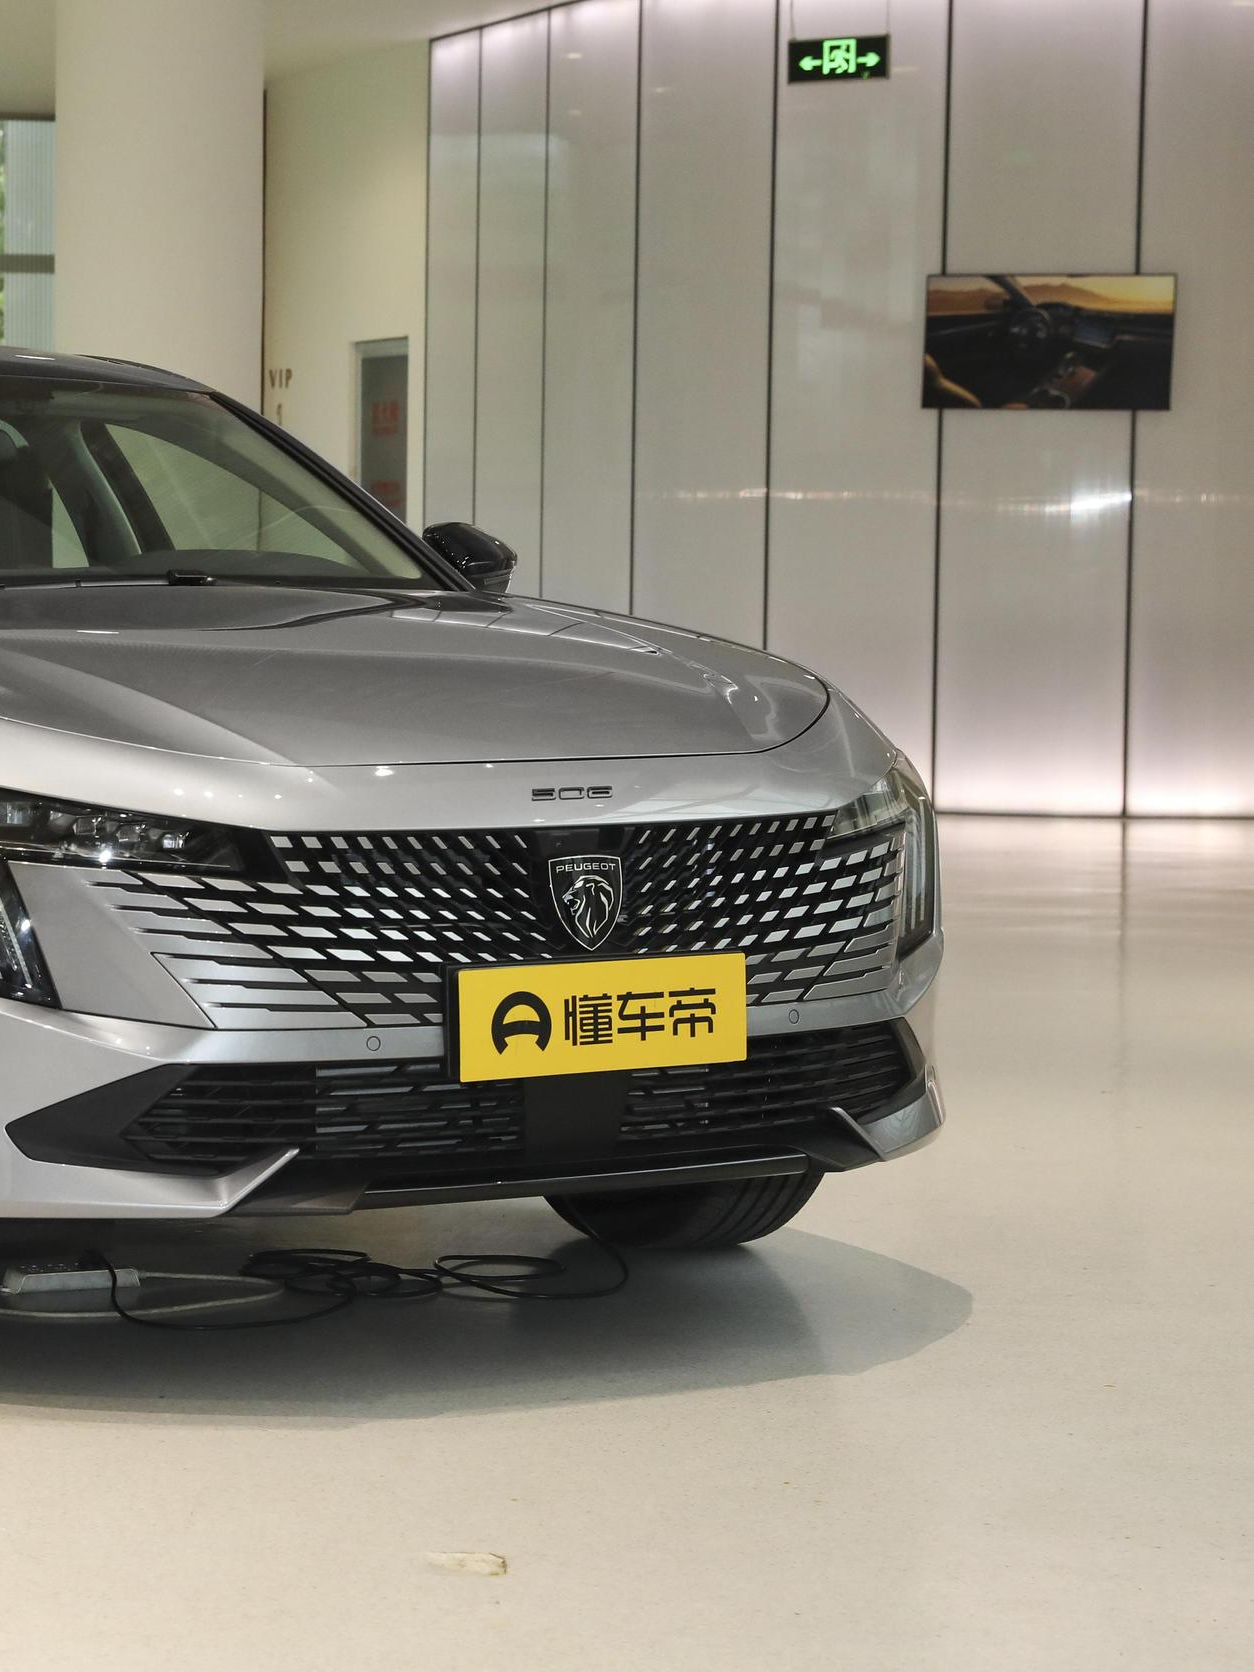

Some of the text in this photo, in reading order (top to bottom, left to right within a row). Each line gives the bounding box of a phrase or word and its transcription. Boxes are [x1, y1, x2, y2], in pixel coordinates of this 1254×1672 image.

[269, 368, 293, 389] VIP
[555, 862, 616, 874] PEUGEOT
[563, 987, 717, 1047] 懂车帝
